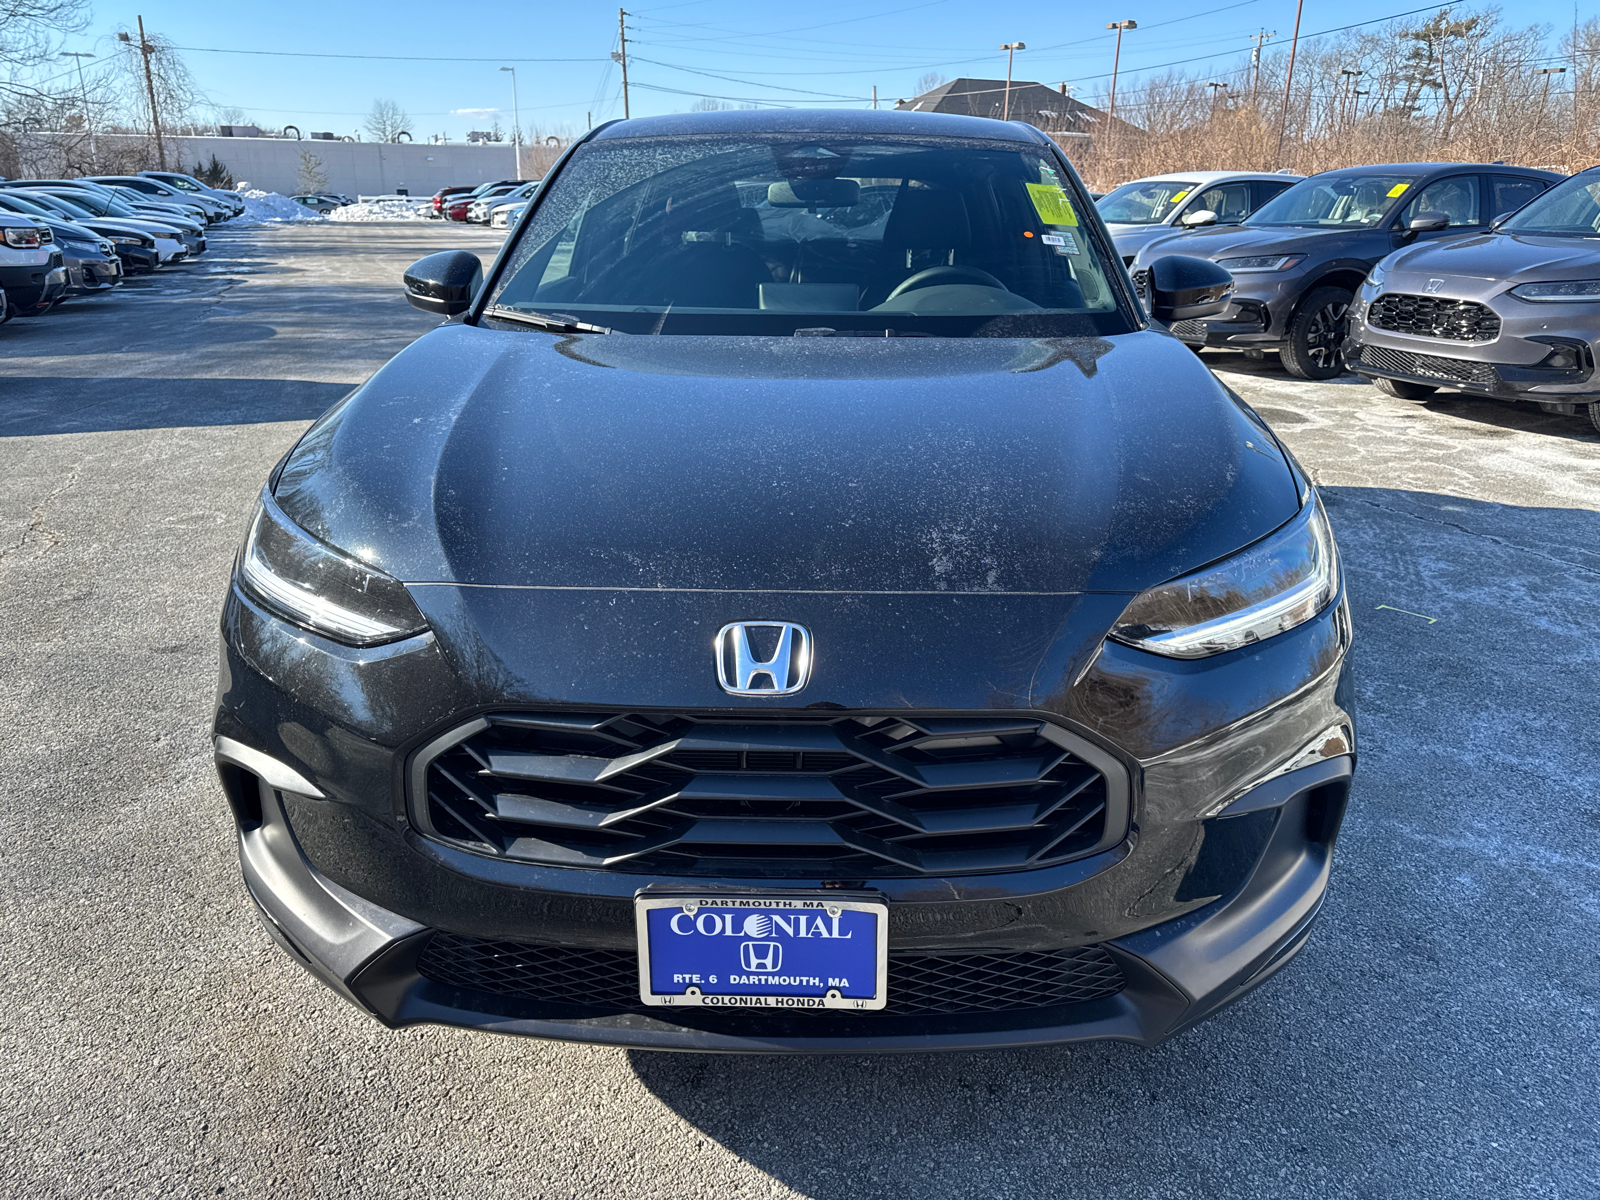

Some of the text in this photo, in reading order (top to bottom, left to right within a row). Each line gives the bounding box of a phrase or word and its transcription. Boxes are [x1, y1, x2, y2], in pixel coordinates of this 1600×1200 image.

[699, 900, 797, 908] DARTMOUTH,
[670, 912, 852, 939] COLONIAL
[673, 974, 850, 988] RTE. 6 DARTMOUTH, MA
[701, 996, 825, 1007] COLONIAL HONDA
